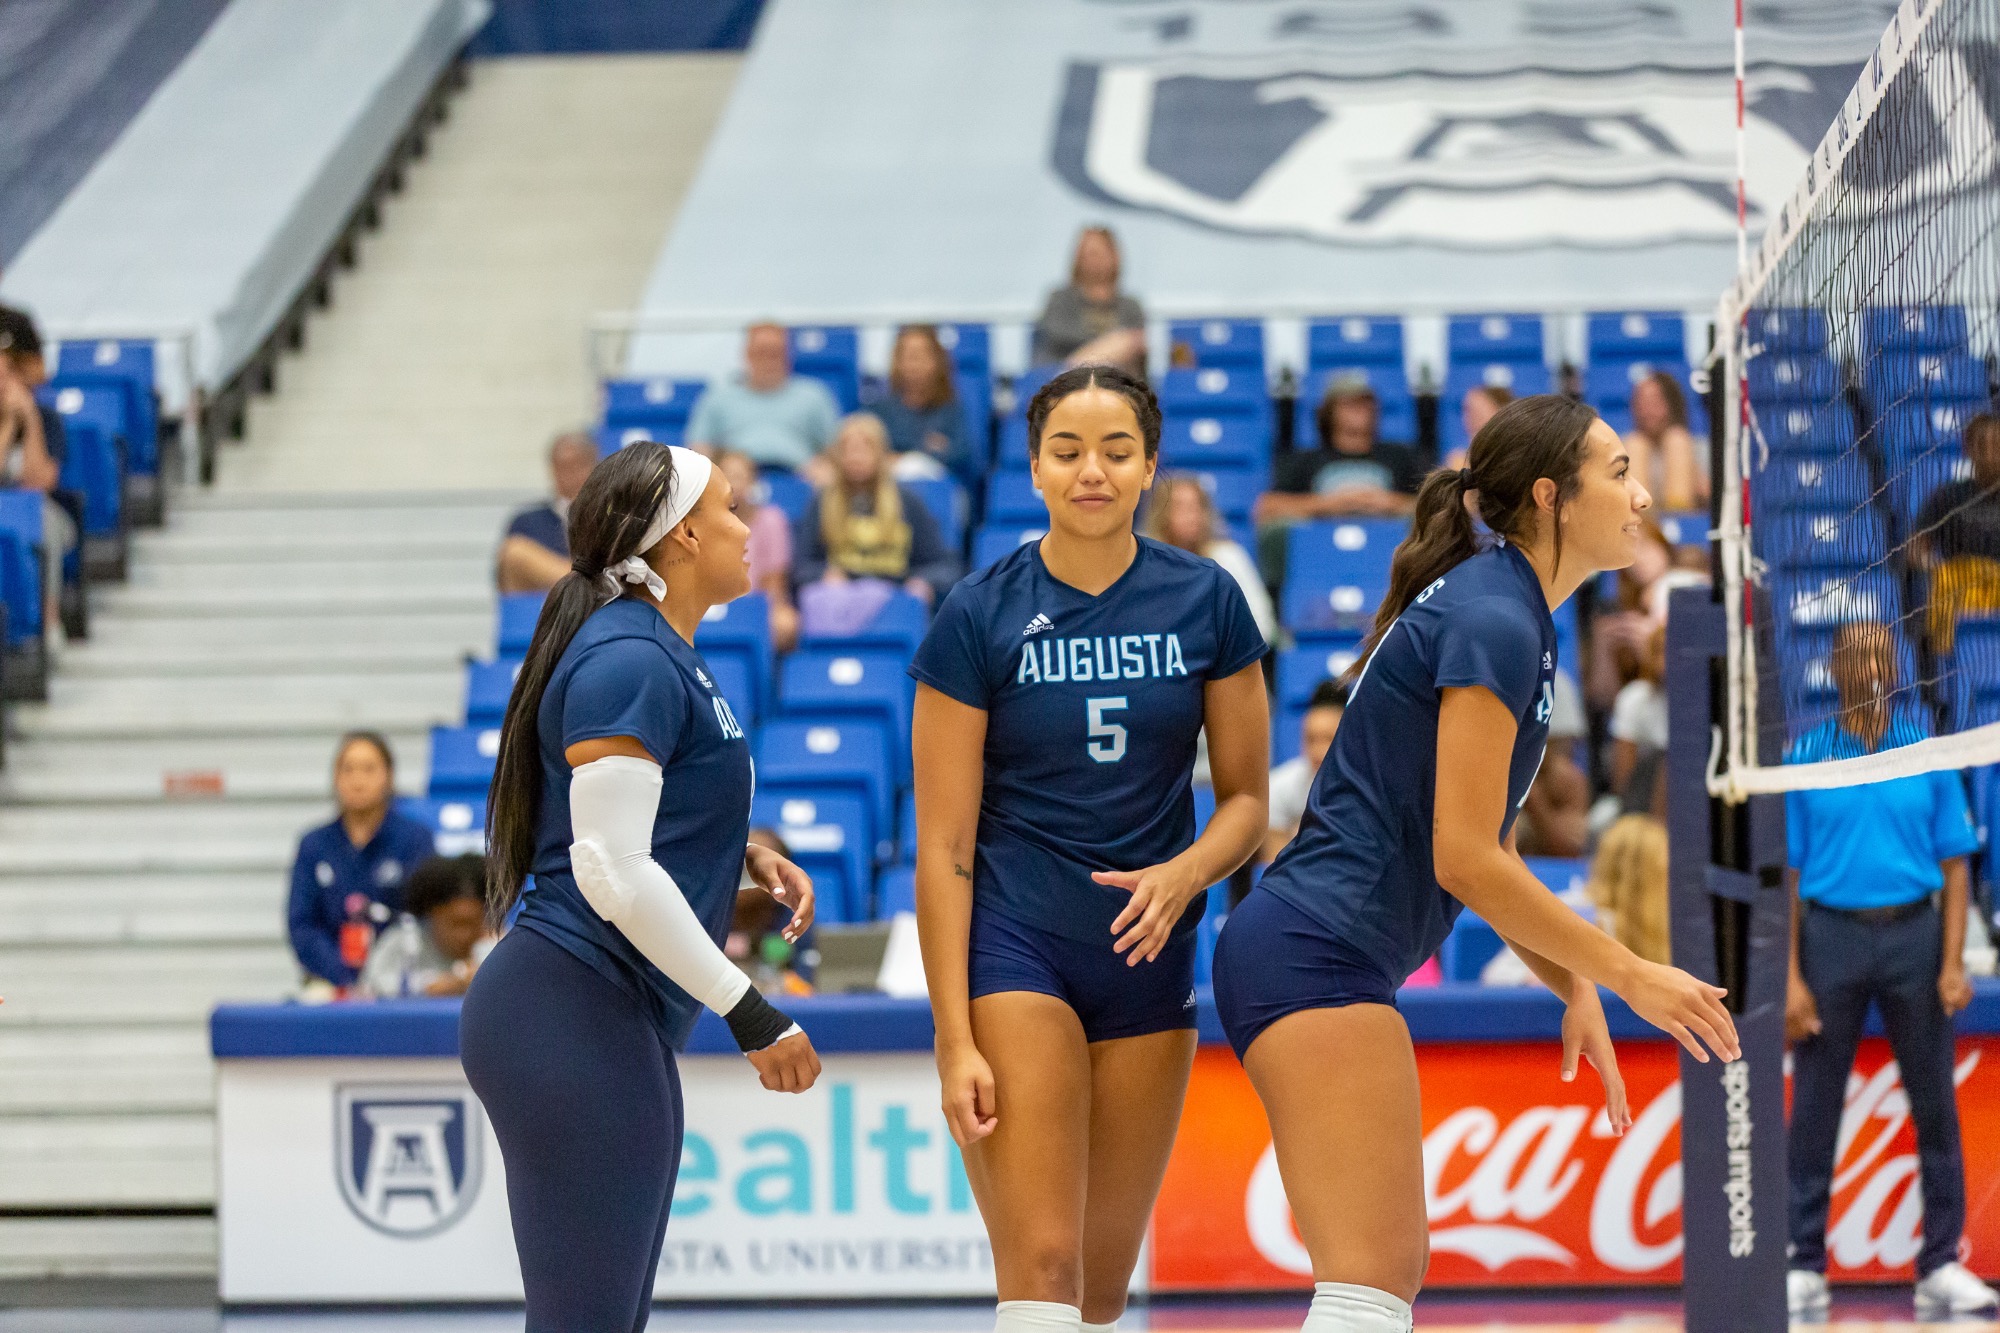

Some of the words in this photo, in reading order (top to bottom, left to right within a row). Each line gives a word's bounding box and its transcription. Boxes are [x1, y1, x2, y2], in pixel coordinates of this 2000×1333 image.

[1017, 633, 1188, 684] AUGUSTA
[1086, 696, 1128, 763] 5
[1720, 1060, 1754, 1149] sports
